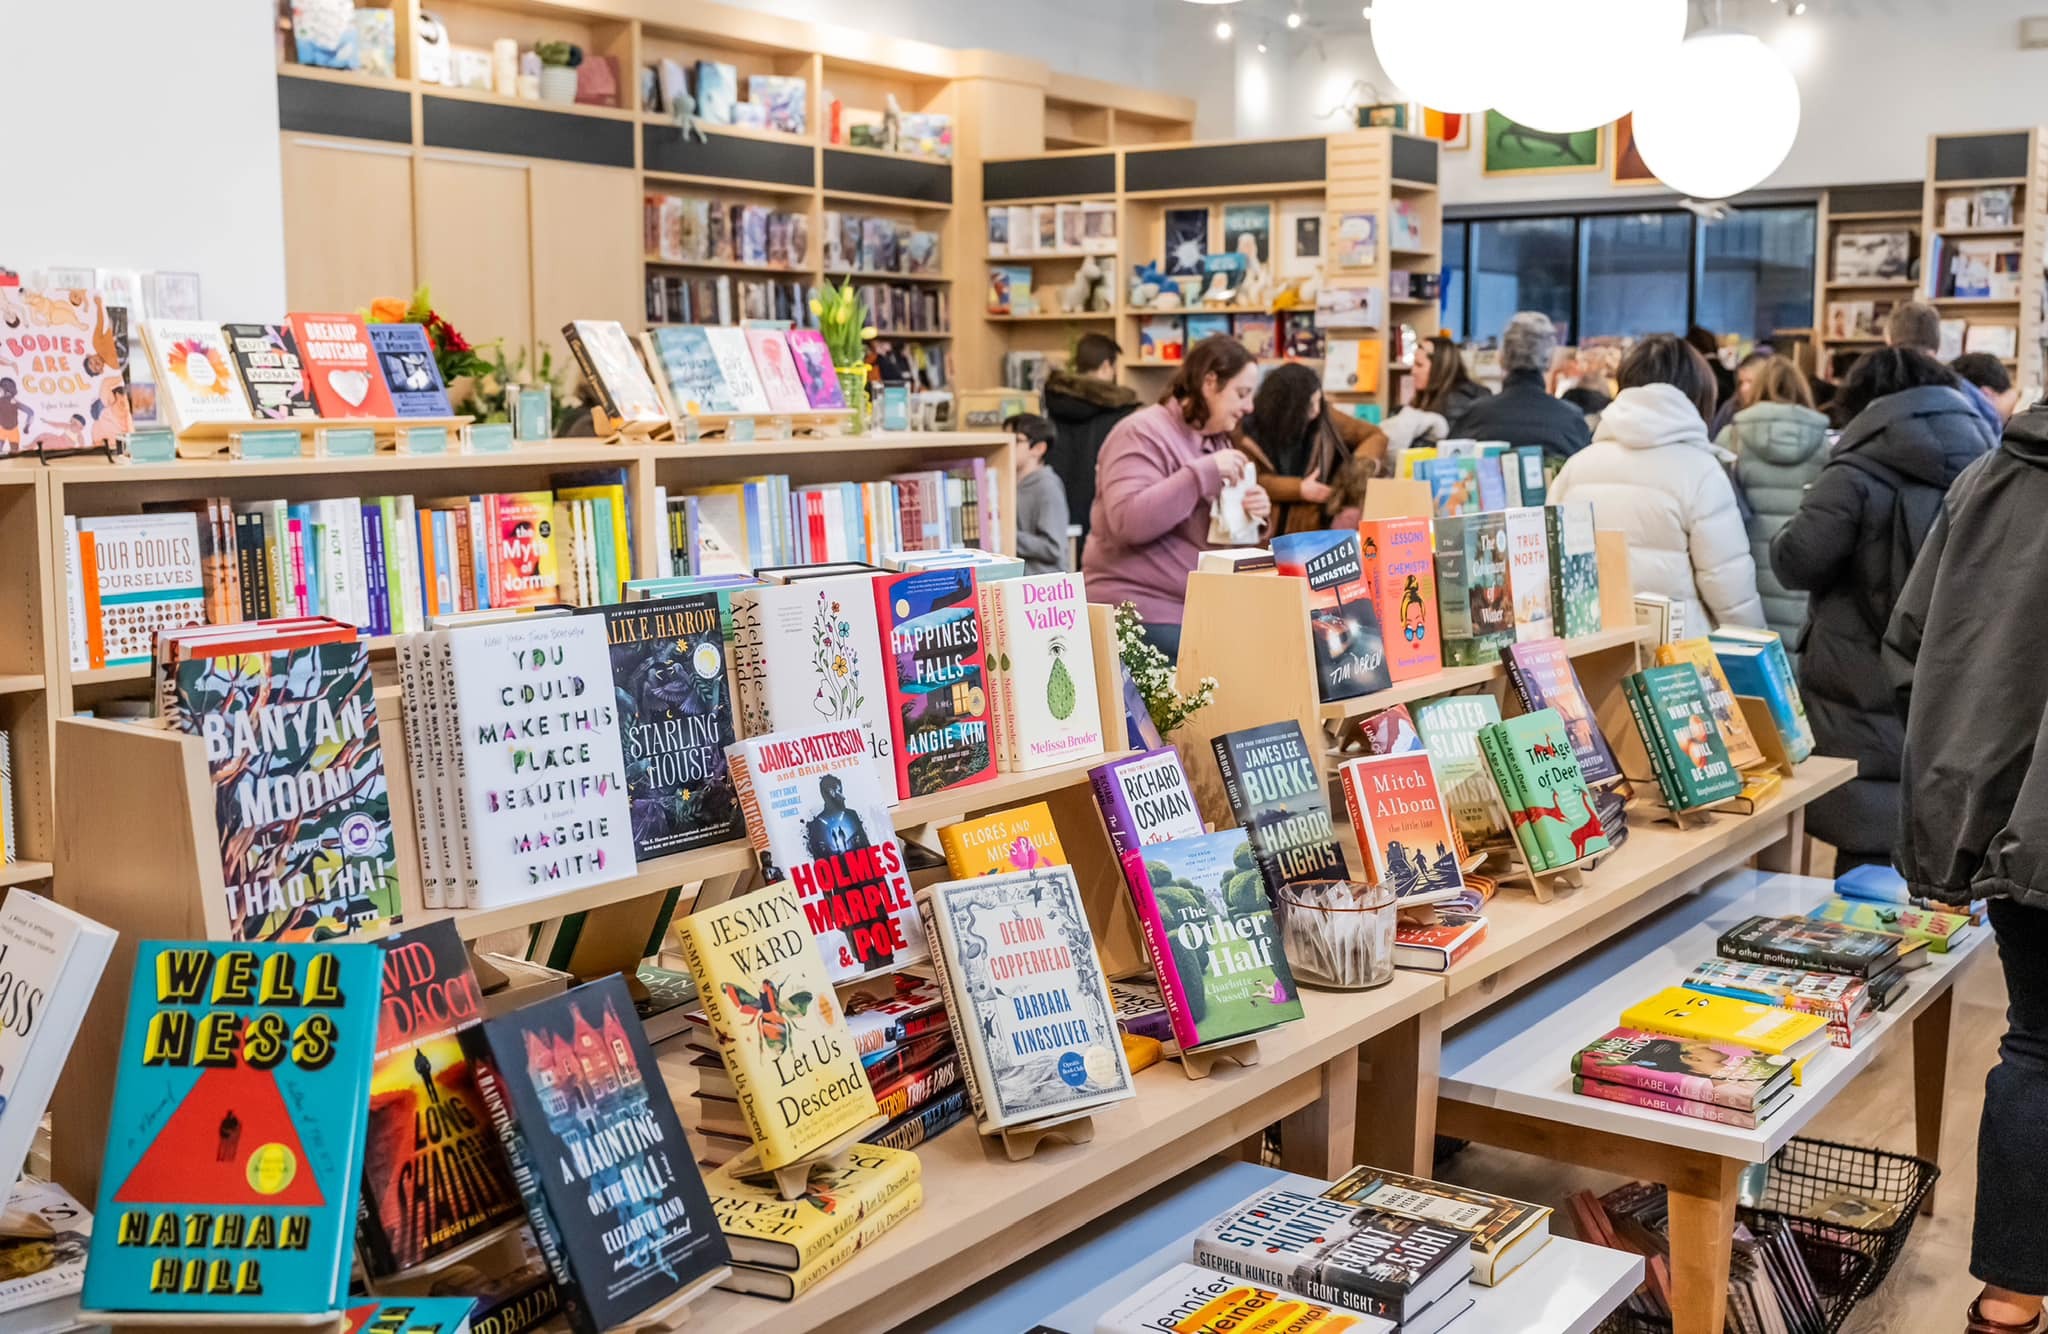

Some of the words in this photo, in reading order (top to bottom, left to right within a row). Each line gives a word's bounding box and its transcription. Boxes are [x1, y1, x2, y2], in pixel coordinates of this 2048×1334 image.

[6, 334, 86, 357] BODIES
[304, 322, 358, 341] BREAKUP
[32, 355, 71, 372] ARE
[251, 353, 280, 366] LIKE
[306, 342, 368, 361] BOOTCAMP
[22, 373, 92, 395] COOL
[249, 370, 301, 381] WOMAN
[1391, 531, 1425, 546] LESSONS
[1481, 535, 1496, 551] The
[1517, 534, 1540, 547] TRUE
[96, 541, 129, 571] OUR
[1308, 541, 1354, 574] AMERICA
[1388, 560, 1429, 576] CHEMISTRY
[1514, 551, 1545, 566] NORTH
[99, 570, 194, 589] OURSELVES
[1311, 561, 1359, 586] FANTASTICA
[1023, 578, 1076, 605] Death
[639, 617, 653, 640] E.
[656, 608, 716, 638] HARROW
[1024, 607, 1077, 631] Valley
[730, 602, 750, 694] Adelaide
[890, 619, 978, 655] HAPPINESS
[513, 645, 564, 672] YOU
[914, 654, 964, 685] FALLS
[1330, 664, 1351, 685] TIM
[501, 676, 585, 707] COULD
[202, 694, 366, 763] BANYAN
[479, 715, 550, 745] MAKE
[559, 706, 613, 731] THIS
[1423, 702, 1487, 731] MASTER
[629, 712, 720, 760] STARLING
[758, 738, 803, 774] JAMES
[803, 728, 866, 765] PATTERSON
[910, 727, 954, 756] ANGIE
[961, 721, 986, 746] KIM
[1030, 738, 1067, 755] Melissa
[1067, 731, 1098, 748] Broder
[512, 744, 591, 773] PLACE
[649, 746, 714, 789] HOUSE
[777, 771, 796, 783] and
[799, 764, 829, 778] BRIAN
[832, 755, 860, 770] SITTS
[1245, 746, 1282, 768] JAMES
[1283, 741, 1301, 759] LEE
[489, 772, 621, 813] BEAUTIFUL
[1215, 743, 1232, 777] HARBOR
[1227, 780, 1242, 809] LIGHTS
[1242, 757, 1319, 806] BURKE
[1372, 770, 1427, 793] Mitch
[1537, 769, 1552, 788] of
[1552, 765, 1578, 783] Deer
[239, 766, 354, 828] MOON
[1134, 790, 1191, 830] OSMAN
[1376, 797, 1436, 818] Albom
[513, 817, 610, 854] MAGGIE
[962, 822, 1008, 849] FLORES
[1011, 819, 1030, 836] AND
[986, 841, 1018, 863] MISS
[1020, 831, 1057, 855] PAULA
[1261, 811, 1333, 853] HARBOR
[528, 849, 606, 885] SMITH
[791, 841, 901, 899] HOLMES
[1277, 841, 1337, 880] LIGHTS
[224, 872, 305, 921] THAO
[317, 858, 387, 910] THAI
[802, 877, 912, 936] MARPLE
[710, 892, 799, 948] JESMYN
[1178, 905, 1206, 921] The
[839, 946, 854, 968] &
[852, 918, 908, 961] POE
[1000, 917, 1046, 946] DEMON
[1177, 913, 1267, 951] Other
[731, 929, 804, 976] WARD
[990, 946, 1071, 980] COPPERHEAD
[1206, 936, 1274, 978] Half
[1723, 944, 1736, 956] the
[1738, 947, 1762, 960] other
[1764, 952, 1799, 966] mothers
[155, 948, 346, 1007] WELL
[1204, 976, 1252, 995] Charlotte
[1013, 988, 1072, 1021] BARBARA
[1216, 989, 1250, 1004] Vassell
[142, 1010, 339, 1072] NESS
[680, 929, 706, 979] JESMYN
[702, 982, 722, 1022] WARD
[726, 1049, 738, 1069] Let
[735, 1071, 746, 1091] Us
[742, 1092, 768, 1142] Descend
[1012, 1019, 1091, 1056] KINGSOLVER
[772, 1052, 811, 1087] Let
[812, 1035, 841, 1065] Us
[777, 1062, 863, 1129] Descend
[1637, 1078, 1670, 1093] ISABEL
[1672, 1085, 1720, 1102] ALLENDE
[414, 1096, 477, 1152] LONG
[560, 1156, 575, 1185] A
[571, 1109, 664, 1179] HAUNTING
[587, 1189, 607, 1216] ON
[603, 1179, 626, 1208] THE
[620, 1155, 668, 1204] HILL
[1382, 1193, 1402, 1206] CURSE
[116, 1210, 312, 1251] NATHAN
[431, 1218, 468, 1243] MEMORY
[602, 1209, 659, 1255] ELIZABETH
[656, 1196, 685, 1226] HAND
[1218, 1190, 1315, 1248] STEPHEN
[1262, 1200, 1356, 1253] HUNTER
[1456, 1206, 1481, 1222] MILLER
[1331, 1226, 1402, 1274] FRONT
[1385, 1225, 1458, 1273] SIGHT
[149, 1258, 264, 1296] HILL
[1200, 1252, 1242, 1275] STEPHEN
[1245, 1265, 1283, 1287] HUNTER
[1307, 1280, 1340, 1303] FRONT
[1343, 1290, 1374, 1313] SIGHT
[1141, 1276, 1234, 1334] Jennifer
